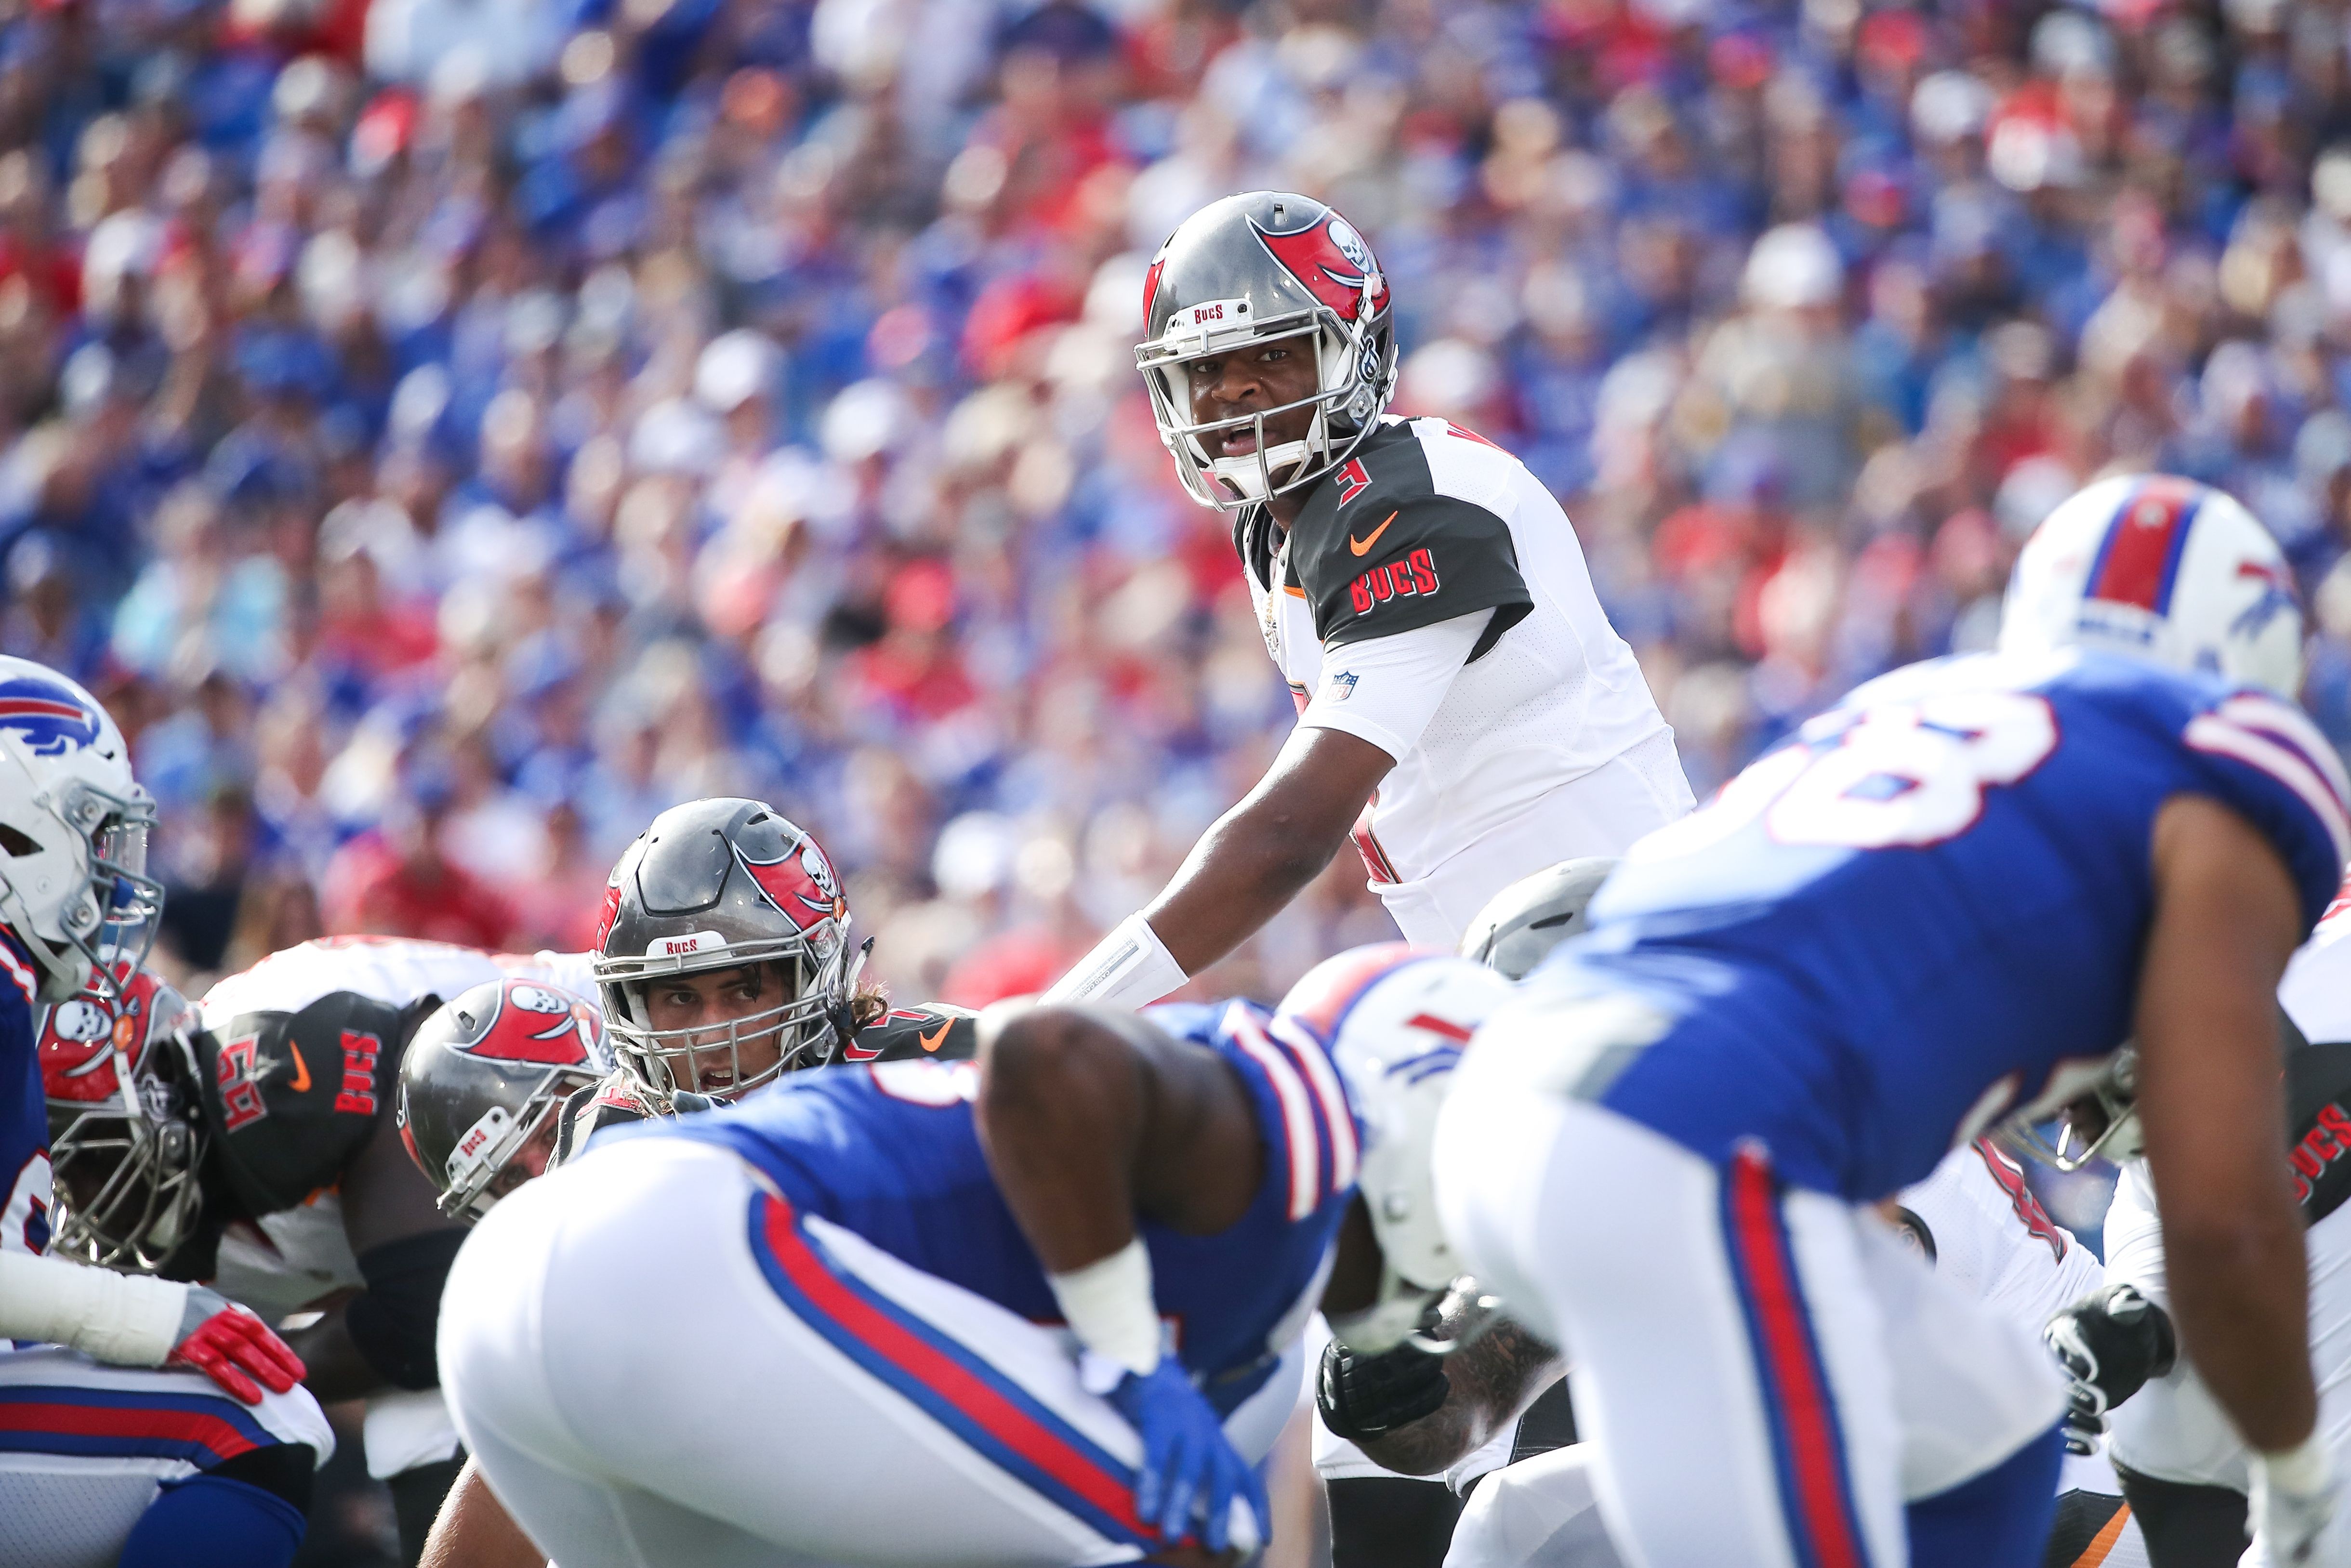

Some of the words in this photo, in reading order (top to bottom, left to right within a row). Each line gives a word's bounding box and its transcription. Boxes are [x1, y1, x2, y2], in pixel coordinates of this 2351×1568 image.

[1194, 304, 1223, 324] BUCS
[1349, 548, 1440, 617] BUCS
[666, 939, 697, 955] BUCS
[1094, 970, 1111, 985] CARD
[216, 1032, 268, 1133] 69
[334, 1028, 382, 1116] BUCS
